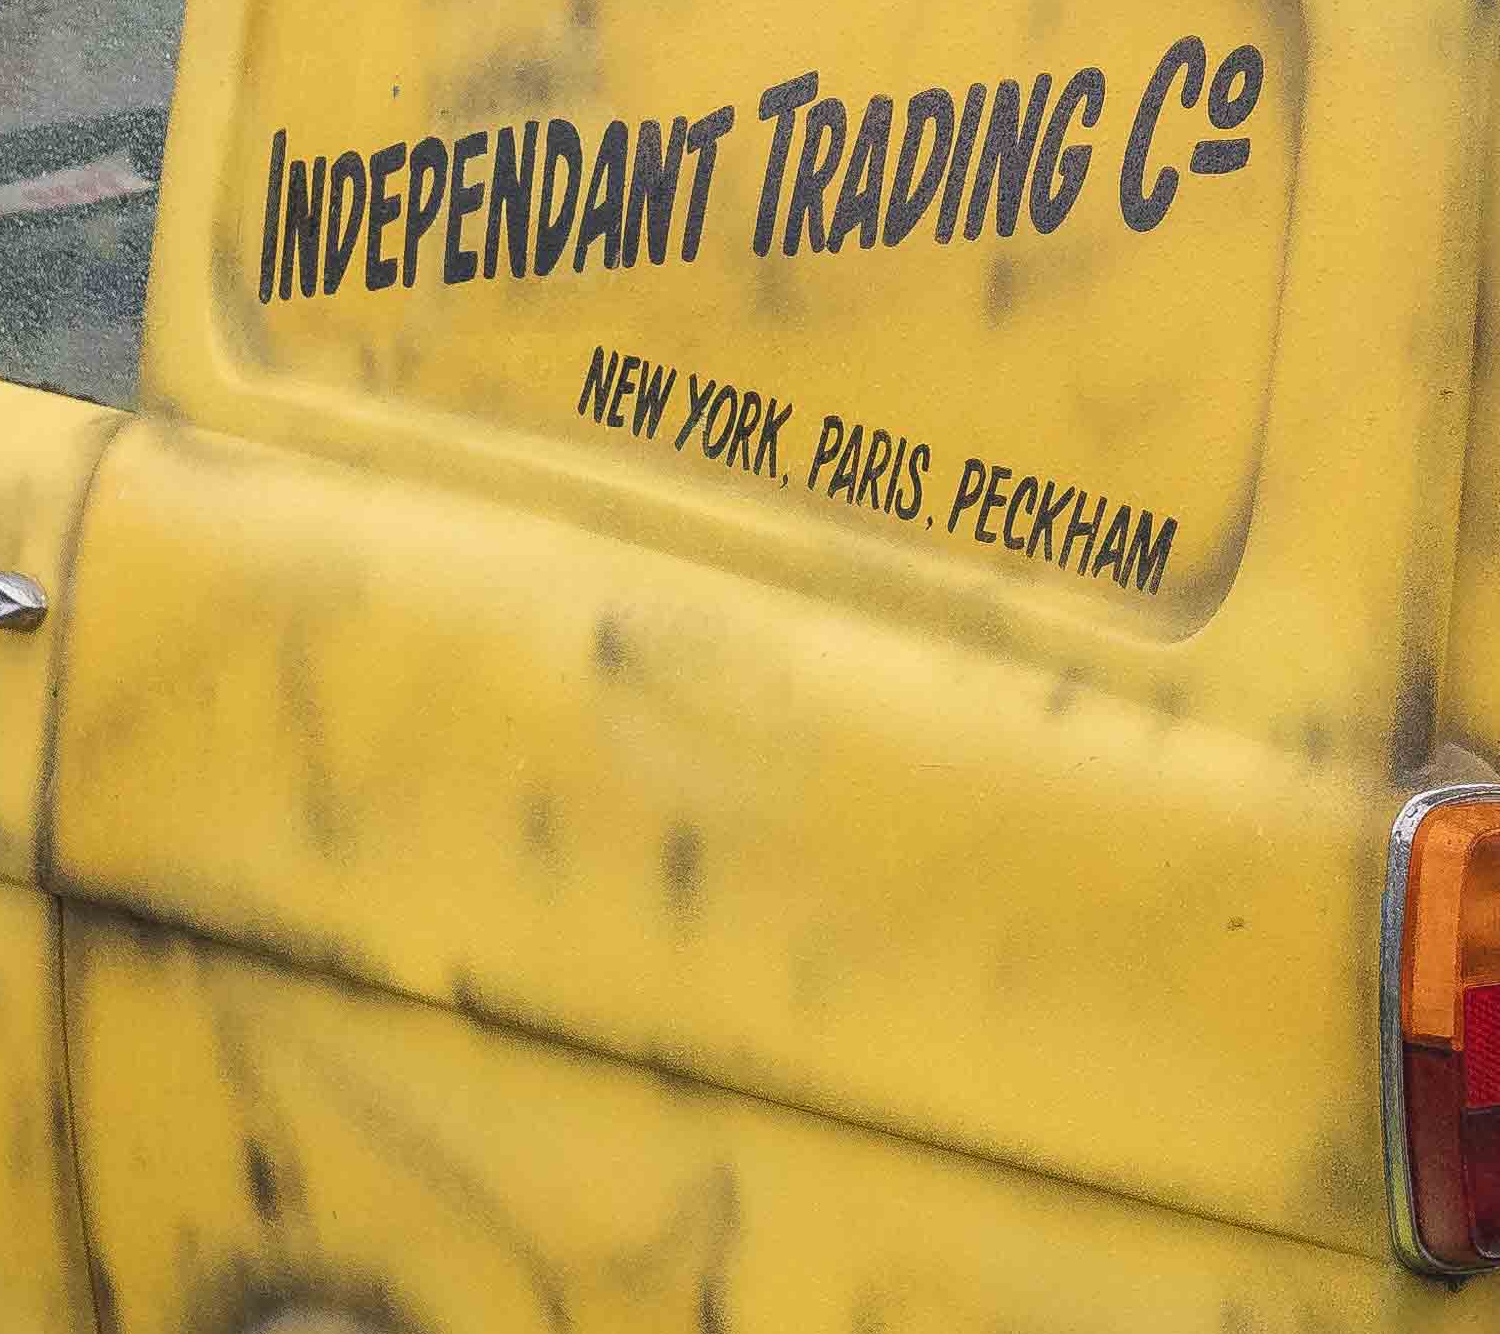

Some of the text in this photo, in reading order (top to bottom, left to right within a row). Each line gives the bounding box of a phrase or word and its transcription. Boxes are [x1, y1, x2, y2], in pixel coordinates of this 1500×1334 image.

[257, 105, 736, 306] INDEPENDANT
[751, 70, 1107, 259] TRADING
[576, 345, 1179, 597] NEW YORK, PARIS, PECKHAM
